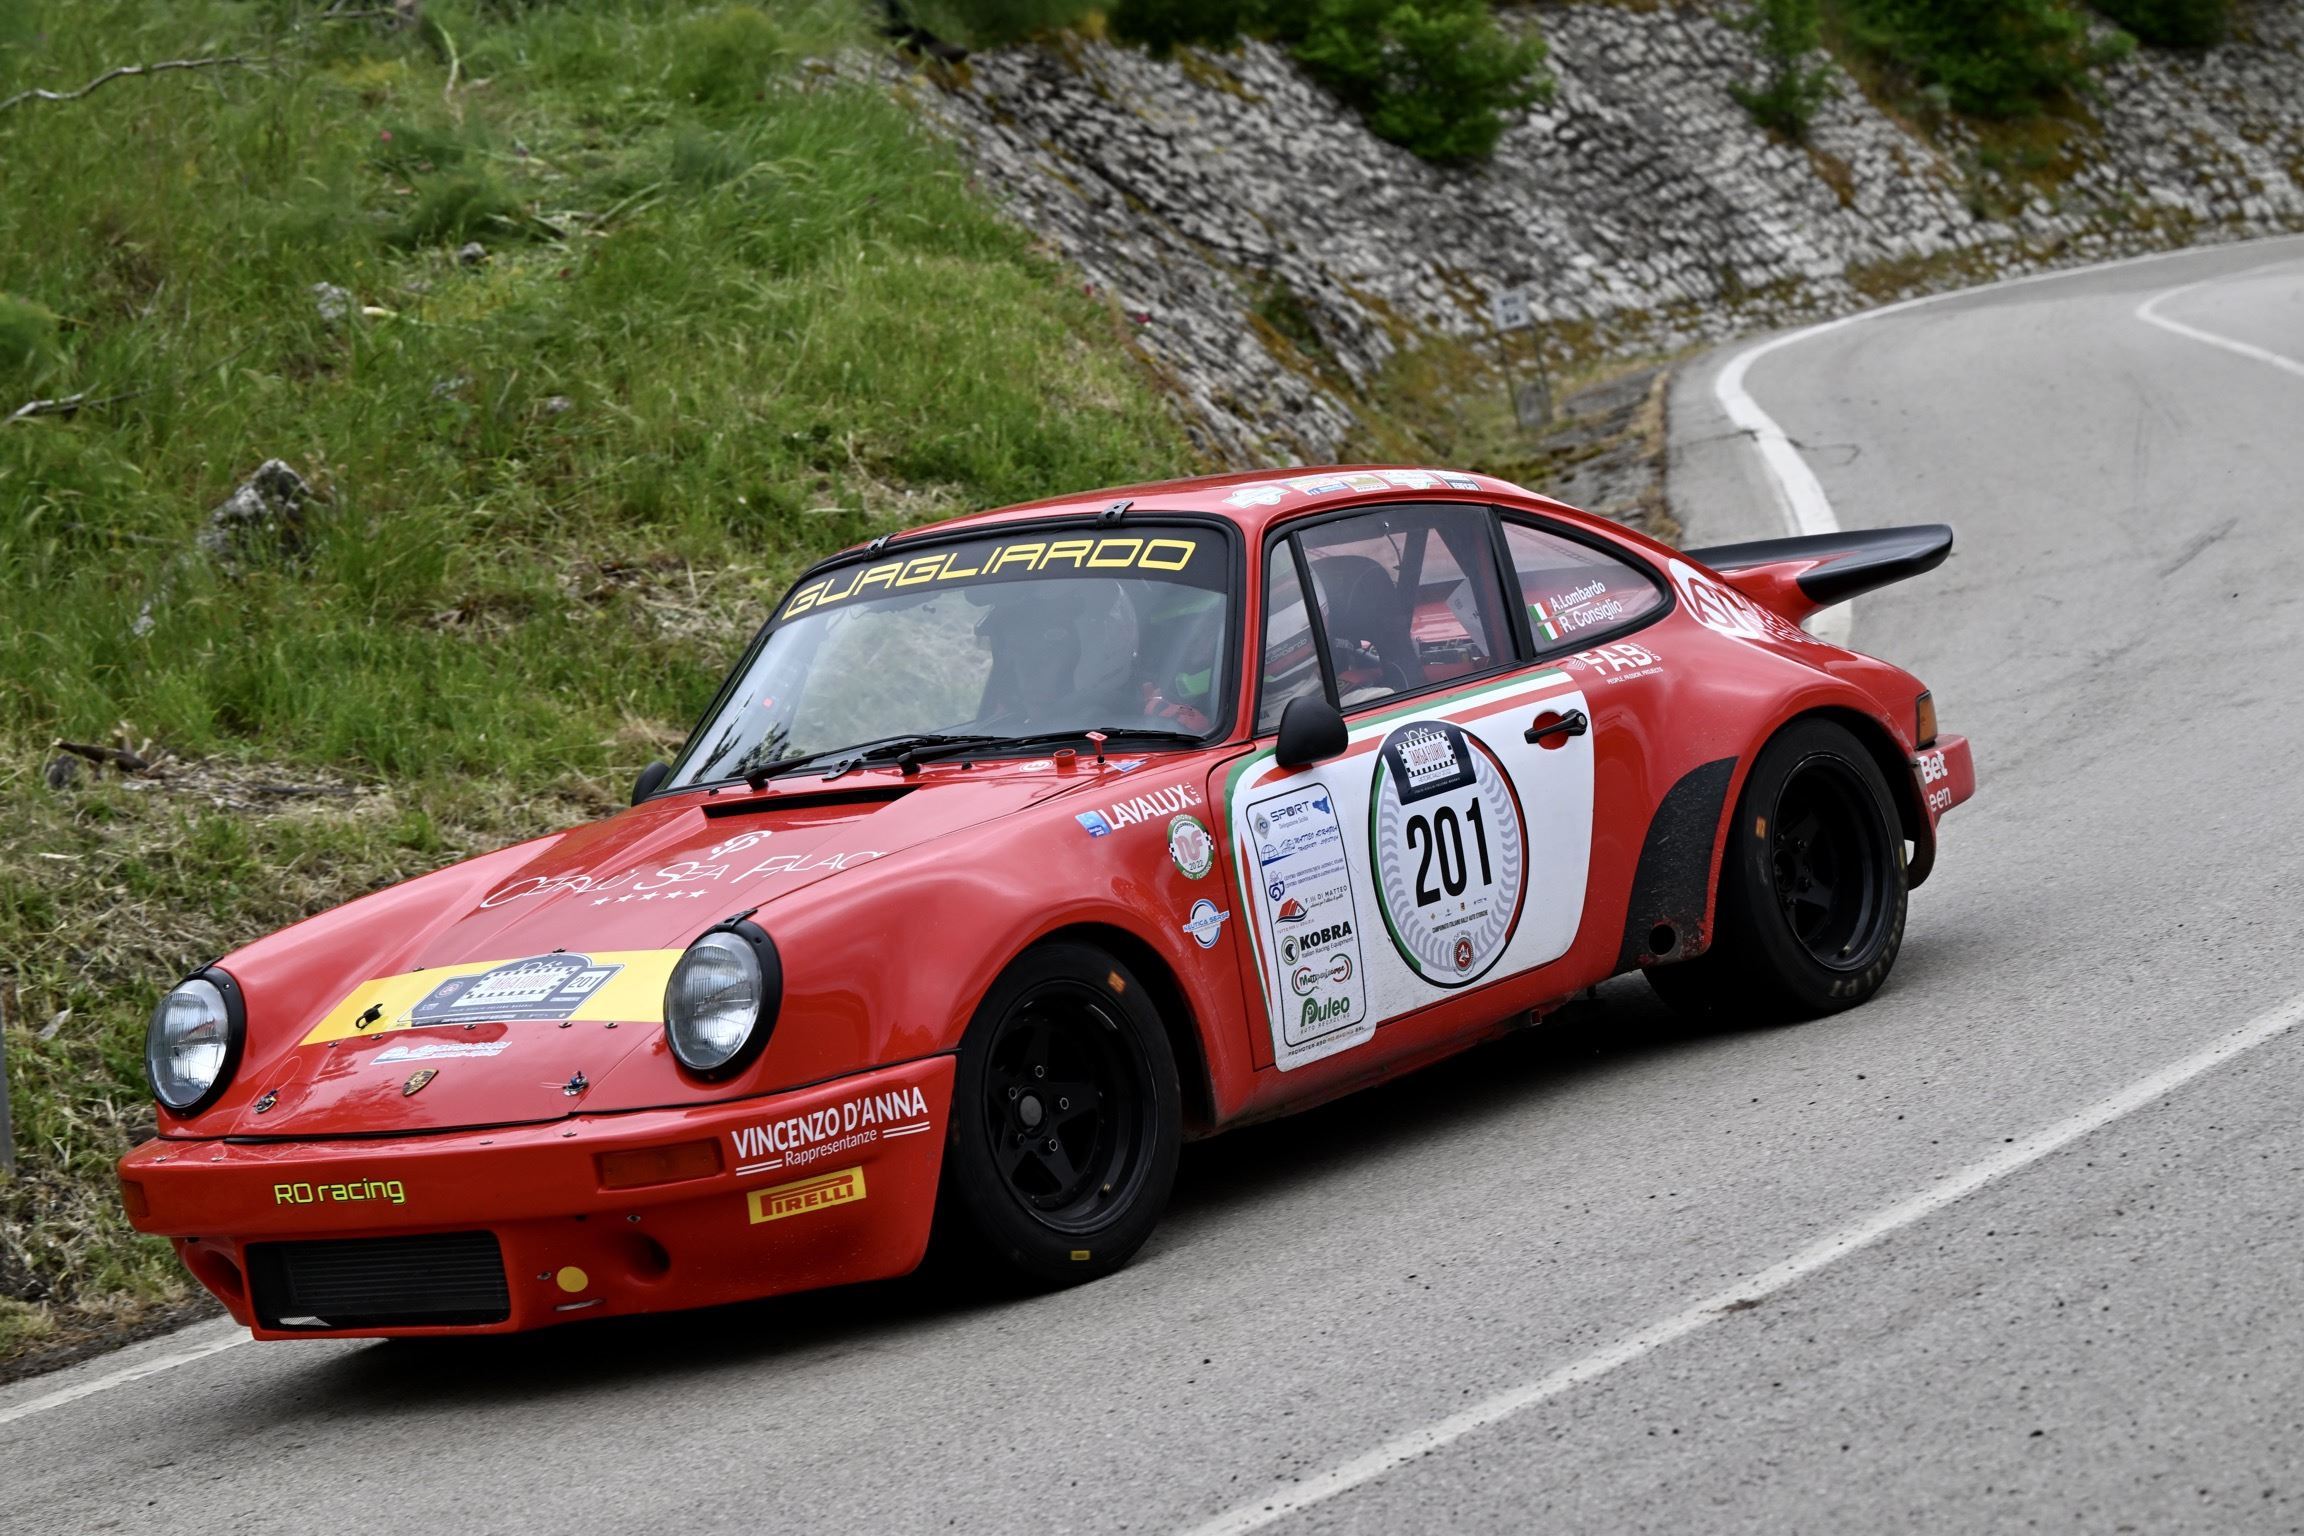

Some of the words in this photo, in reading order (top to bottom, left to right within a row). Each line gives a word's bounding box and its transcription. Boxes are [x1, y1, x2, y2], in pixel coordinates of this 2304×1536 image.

[782, 538, 1196, 621] GUAGLIARDO
[1550, 580, 1606, 612] A.Lombardo
[1574, 598, 1623, 628] Consiglio
[1917, 751, 1948, 784] Bet
[1097, 784, 1196, 830] LAVALUX
[1270, 801, 1310, 822] SPORT
[1929, 787, 1951, 812] een
[1406, 797, 1492, 908] 201
[632, 862, 730, 891] SEA
[1300, 921, 1352, 951] KOBRA
[568, 973, 602, 989] 201
[731, 1107, 840, 1159] VINCENZO
[843, 1086, 928, 1132] D'ANNA
[785, 1129, 877, 1166] Rappresentanze
[273, 1182, 313, 1205] RO
[318, 1178, 406, 1206] racing
[760, 1174, 854, 1217] PIRELLI
